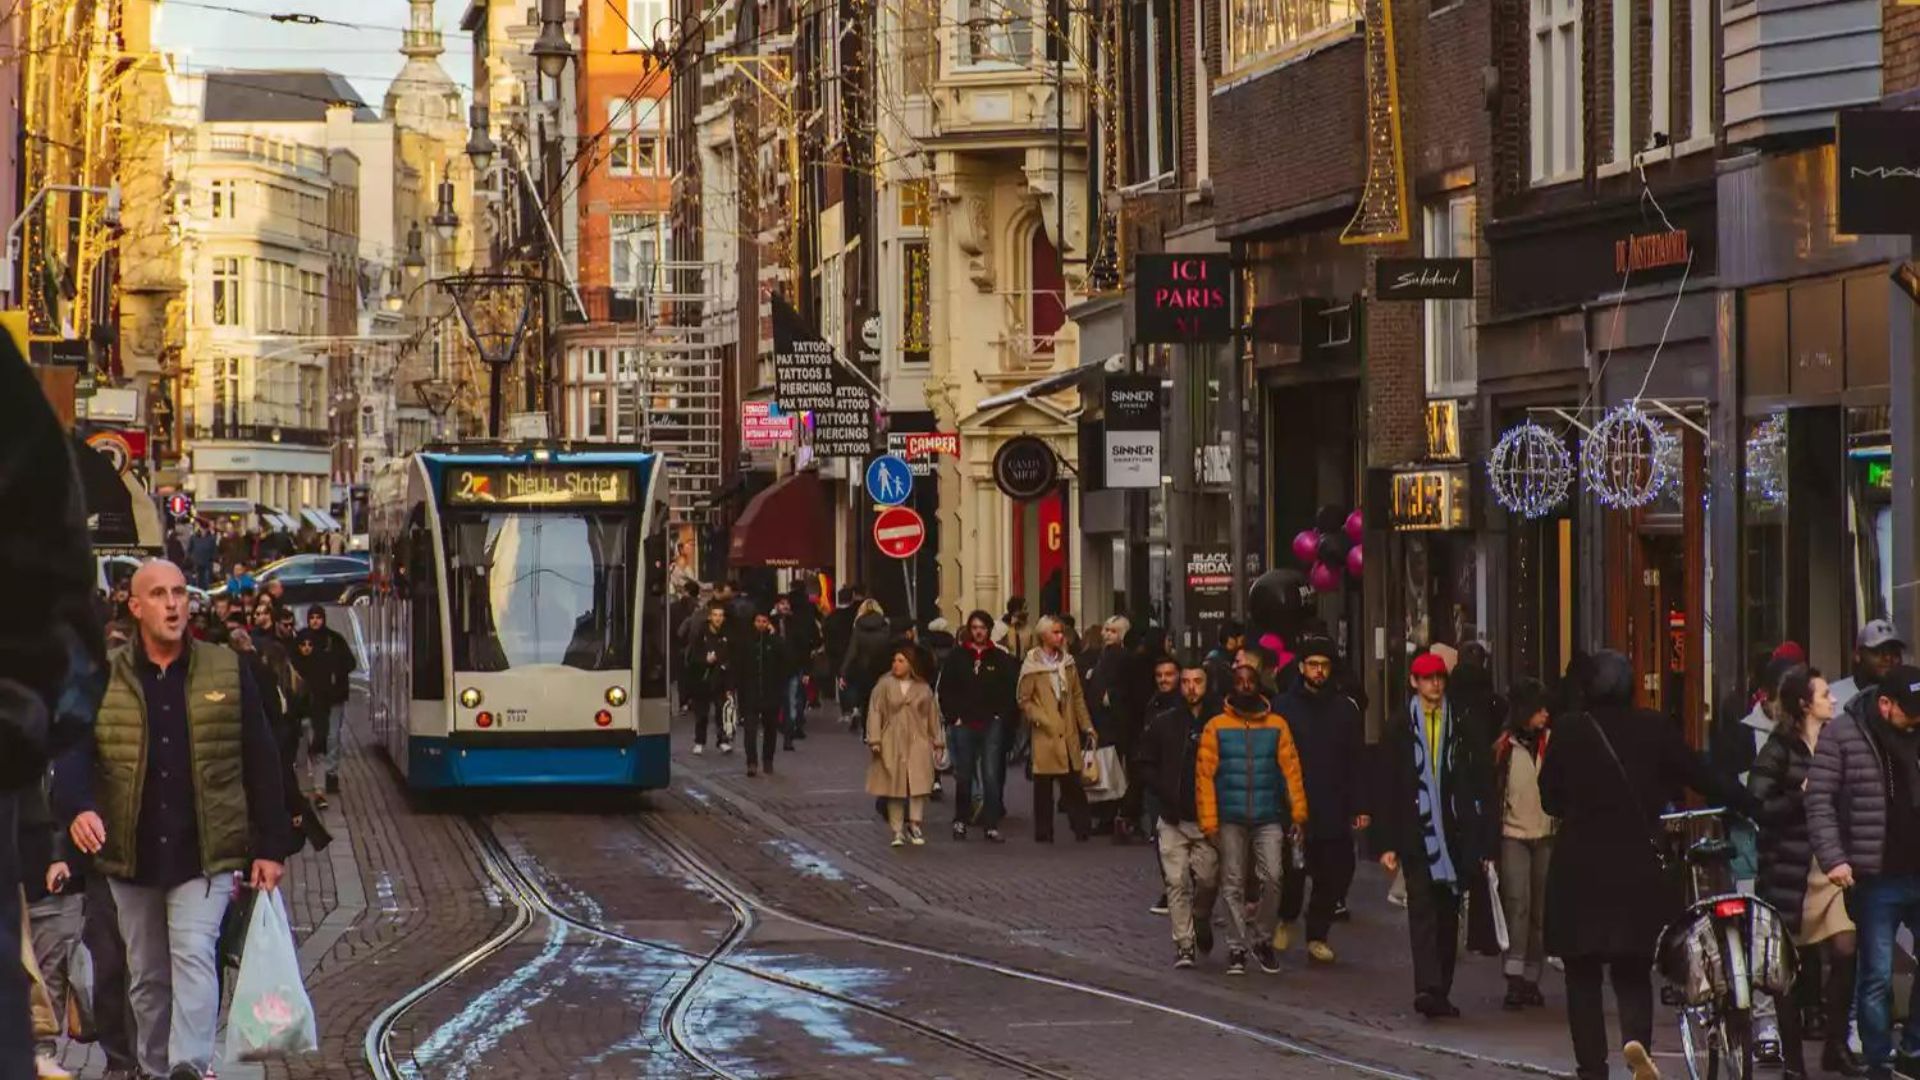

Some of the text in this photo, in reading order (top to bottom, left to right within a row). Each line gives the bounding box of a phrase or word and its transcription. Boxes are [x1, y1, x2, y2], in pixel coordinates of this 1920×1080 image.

[1851, 166, 1920, 178] MA
[1172, 260, 1206, 280] ICI
[1156, 288, 1224, 308] PARIS
[793, 341, 831, 353] TATTOOS
[777, 354, 832, 365] PAX TATTOOS
[778, 367, 832, 380] TATTOOS &
[780, 382, 832, 395] PIERCINGS
[1111, 390, 1154, 402] SINNER
[780, 397, 835, 409] PAX TATTOOS
[837, 398, 870, 409] ATTOOS
[816, 412, 869, 425] TATTOOS &
[816, 427, 869, 439] PIERCINGS
[814, 442, 870, 454] PAX TATTOOS
[909, 436, 957, 455] CAMPER
[1111, 445, 1154, 456] SINNER
[457, 472, 473, 499] 2
[507, 473, 558, 495] Nieuw
[1193, 553, 1228, 563] BLACK
[1187, 562, 1232, 574] FRIDAY
